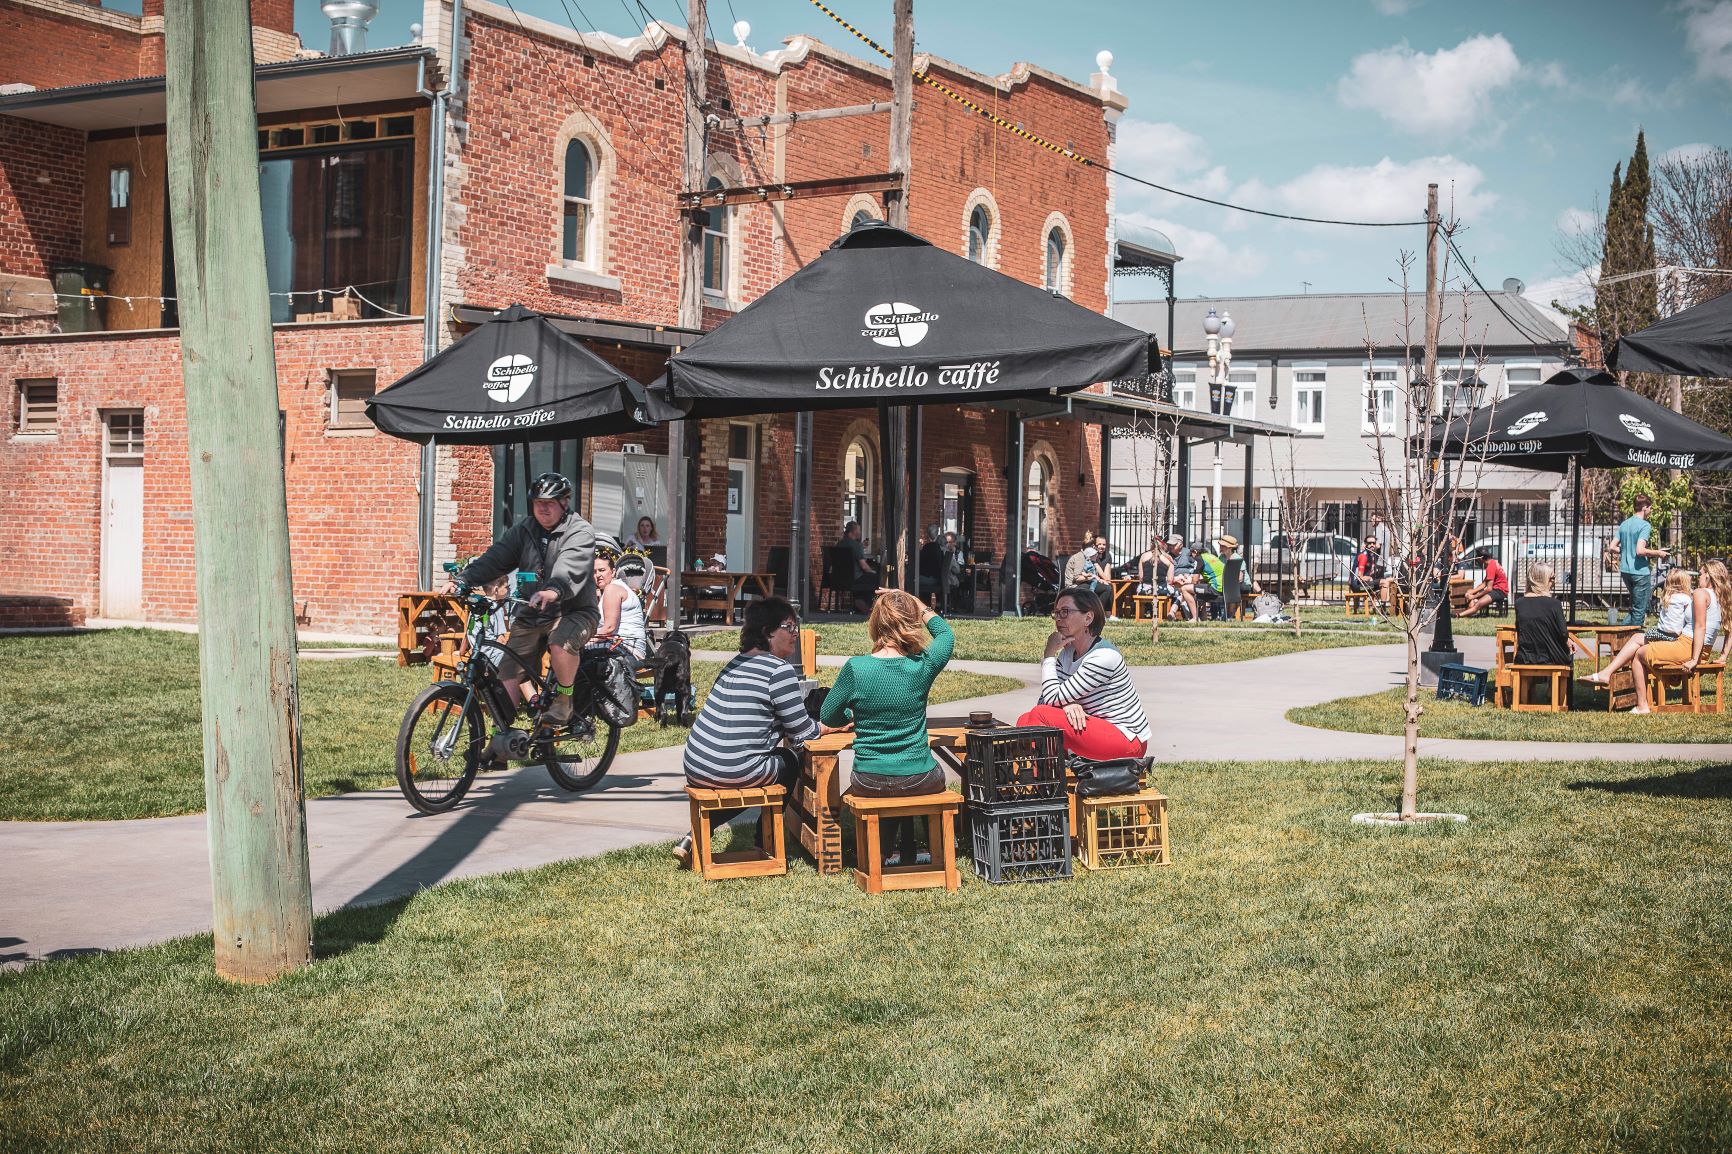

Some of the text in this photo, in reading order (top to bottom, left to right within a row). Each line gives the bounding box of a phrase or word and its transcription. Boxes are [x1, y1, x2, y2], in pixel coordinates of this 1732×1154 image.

[872, 313, 940, 325] Schibello
[861, 327, 897, 337] caffé
[492, 364, 539, 377] Schibello
[815, 360, 1000, 390] Schibello caffé
[482, 381, 510, 390] coffee
[442, 409, 556, 430] Schibello coffee
[1627, 448, 1696, 469] Schibello caffé
